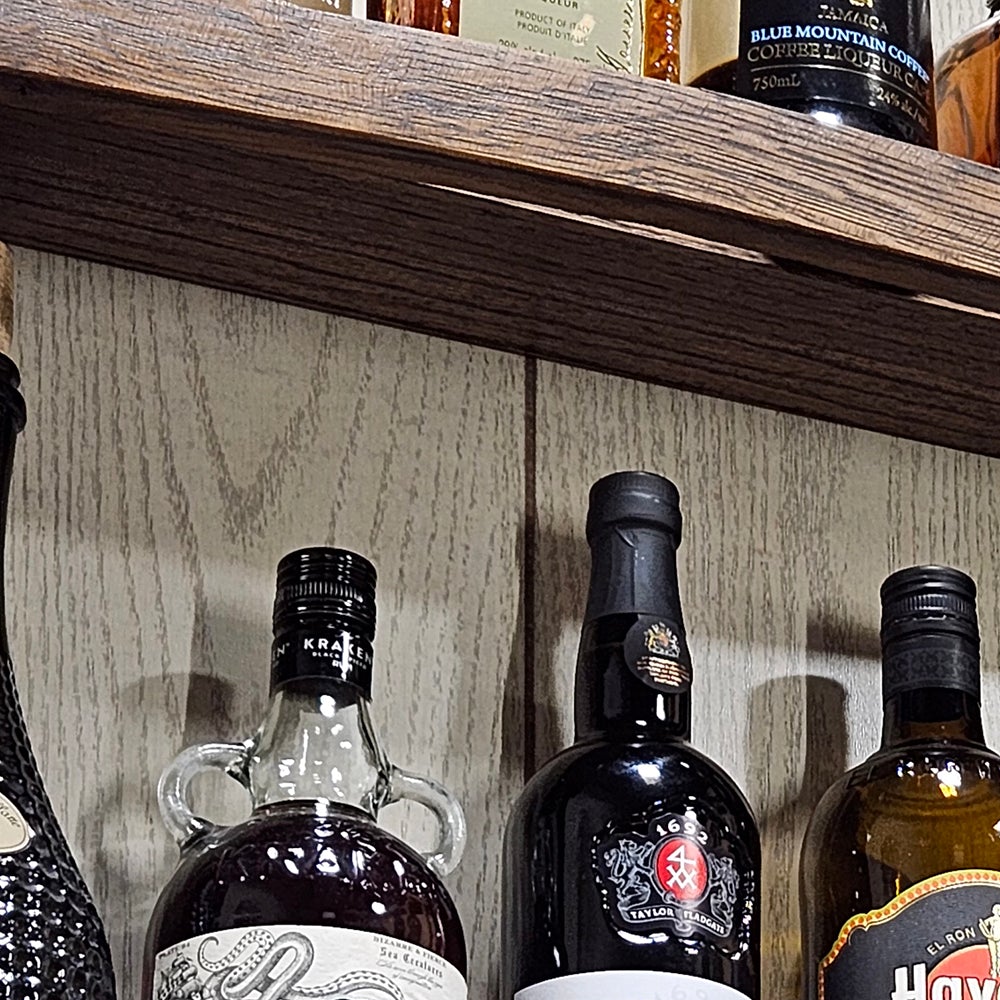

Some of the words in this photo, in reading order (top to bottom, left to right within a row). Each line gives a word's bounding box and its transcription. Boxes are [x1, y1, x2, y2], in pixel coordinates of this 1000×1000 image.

[817, 4, 888, 34] JAMAICA
[750, 25, 792, 43] BLUE
[795, 25, 886, 54] MOUNTAIN
[747, 42, 821, 62] COFFEE
[823, 43, 903, 81] LIQUEUR
[656, 818, 709, 846] 1692
[629, 907, 675, 920] TAYLOR
[683, 910, 726, 935] FLADGATE
[926, 942, 945, 956] EL
[945, 926, 976, 944] RON
